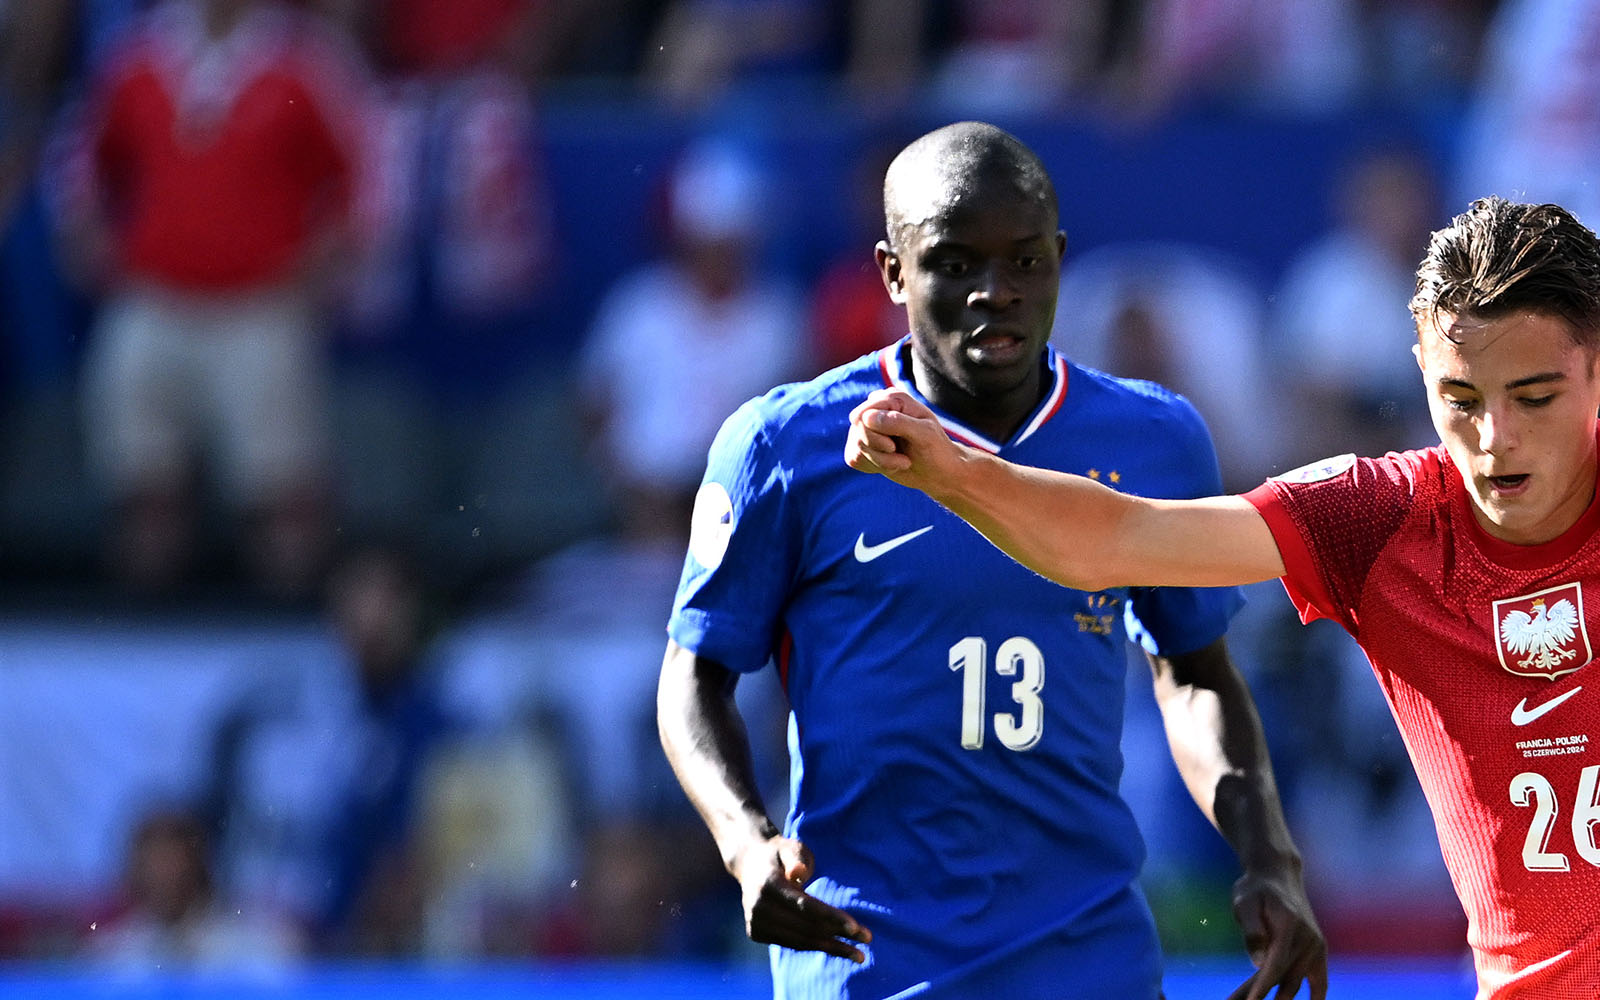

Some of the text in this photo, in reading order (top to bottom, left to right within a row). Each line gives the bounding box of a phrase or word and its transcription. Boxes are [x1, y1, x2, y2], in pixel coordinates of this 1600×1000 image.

[948, 636, 1046, 752] 13
[1522, 750, 1532, 758] 25
[1566, 745, 1585, 754] 2024
